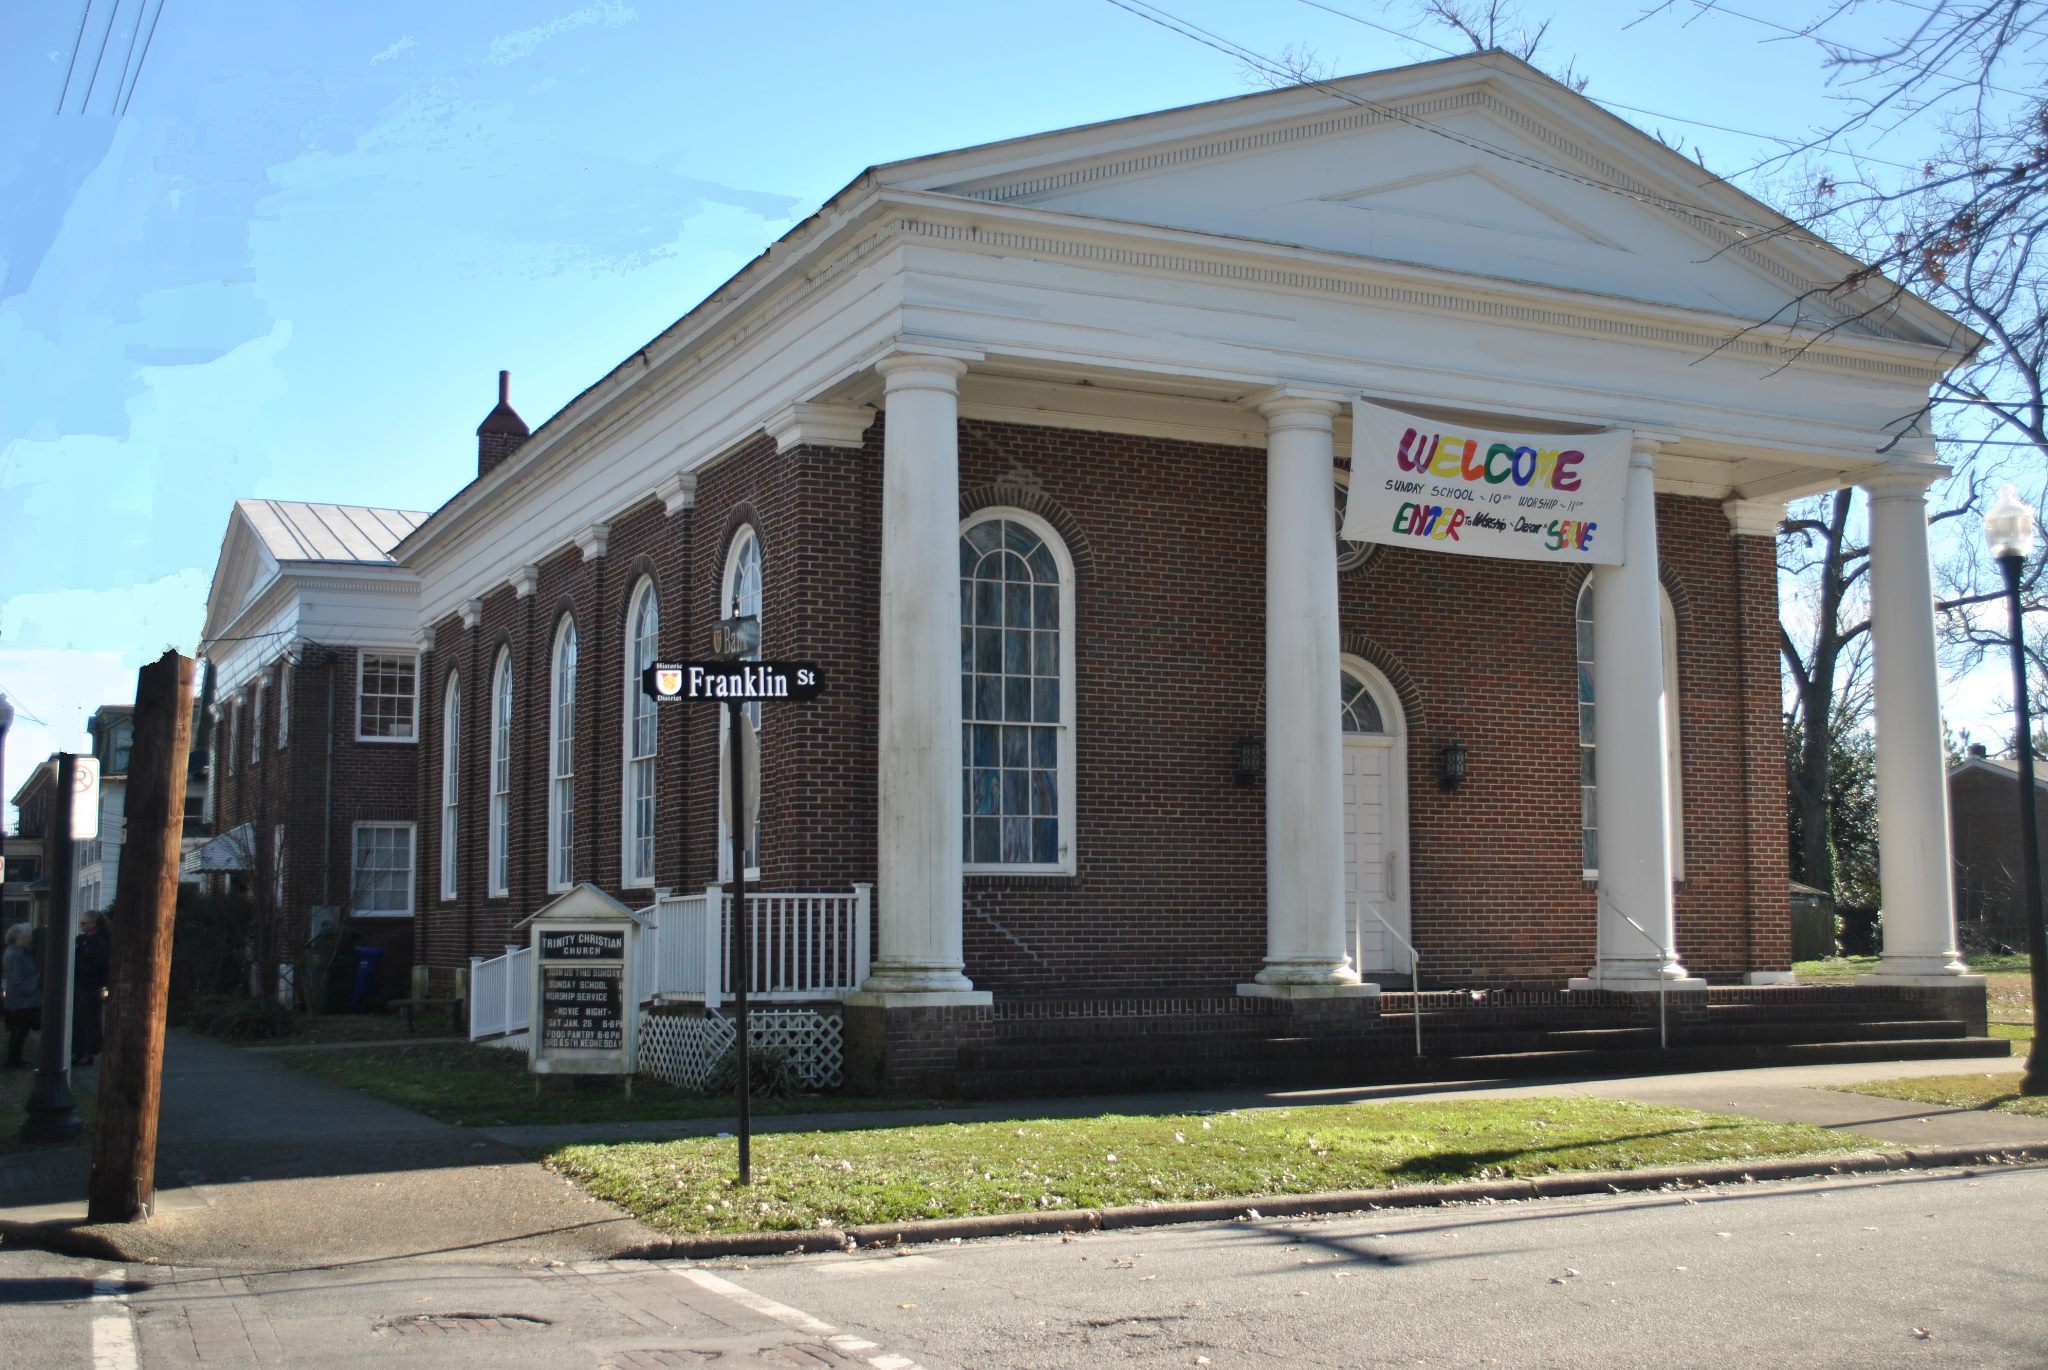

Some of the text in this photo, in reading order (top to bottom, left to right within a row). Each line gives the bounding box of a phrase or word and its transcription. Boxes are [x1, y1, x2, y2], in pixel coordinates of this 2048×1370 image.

[1397, 427, 1585, 492] WELCOME
[1384, 480, 1425, 495] SUNDAY
[1430, 486, 1475, 501] SCHOOL
[1518, 496, 1558, 510] WORSHIP
[1392, 502, 1465, 541] ENTER
[1545, 519, 1597, 551] SERVE
[656, 662, 683, 670] Historic
[689, 666, 816, 697] Franklin St
[543, 933, 622, 949] TRINITY CHRISTIAN
[563, 946, 601, 955] CHURCH
[549, 980, 576, 989] SUNDAY
[580, 981, 608, 990] SCHOOL
[546, 992, 575, 1000] WORSHIP
[577, 992, 607, 1001] SERVICE
[546, 1030, 566, 1039] FOOD
[567, 1031, 595, 1039] PANTRY
